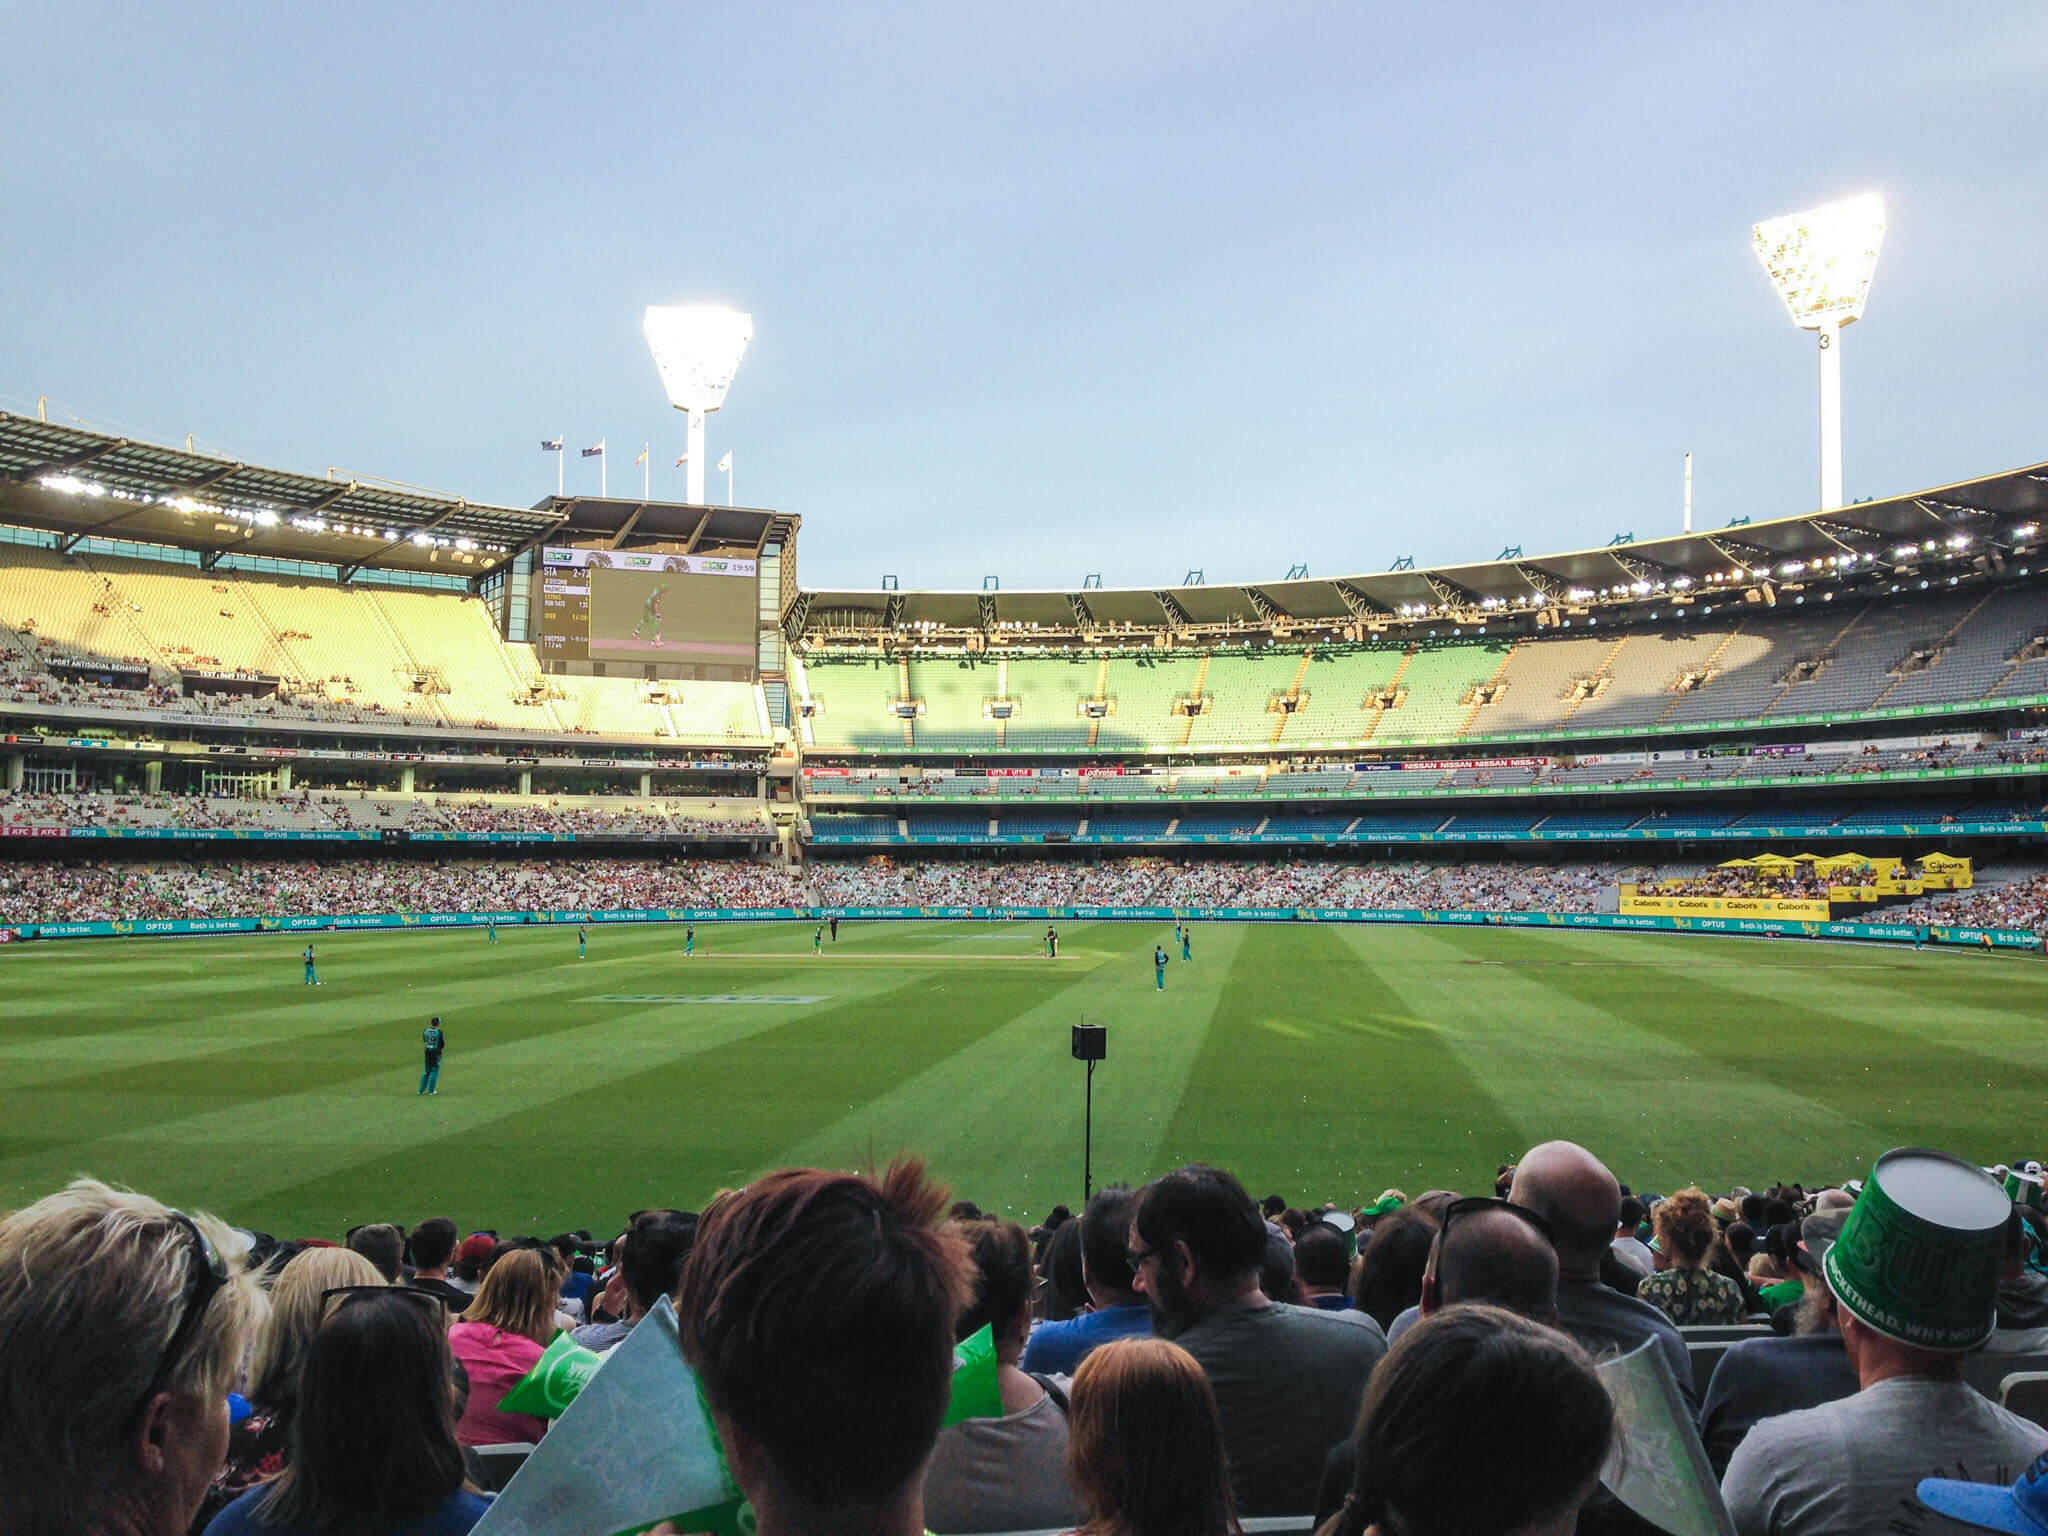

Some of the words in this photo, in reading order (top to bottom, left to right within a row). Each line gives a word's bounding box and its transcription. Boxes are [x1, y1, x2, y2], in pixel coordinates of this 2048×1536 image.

[1820, 334, 1829, 349] 3
[544, 566, 558, 576] STA
[72, 660, 110, 670] ANTISOCIAL
[112, 664, 148, 672] BEHAVIOUR
[40, 926, 58, 935] Both
[146, 922, 173, 931] OPTUS
[1869, 927, 1885, 935] Both
[1906, 1322, 1944, 1340] WHY
